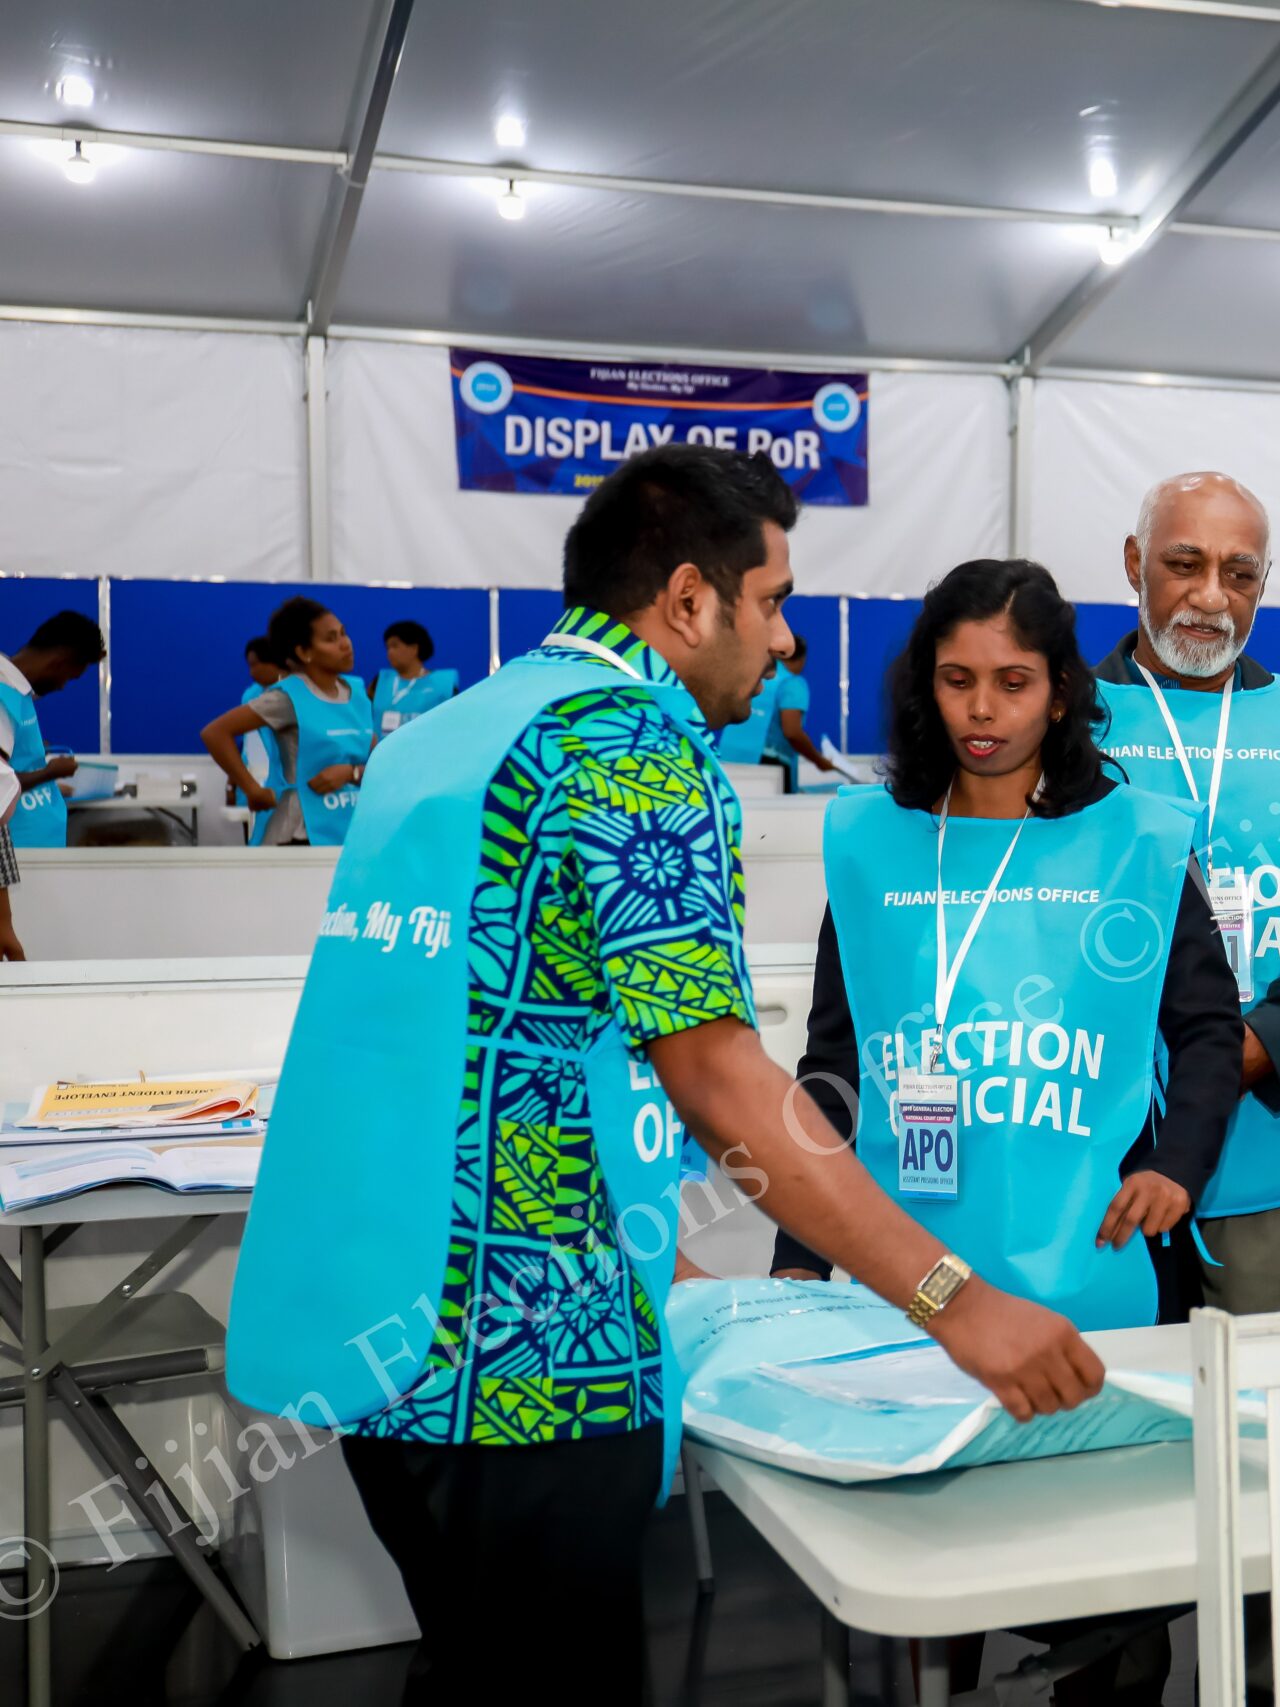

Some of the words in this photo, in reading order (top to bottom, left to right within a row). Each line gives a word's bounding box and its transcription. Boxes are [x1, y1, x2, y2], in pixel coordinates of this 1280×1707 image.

[628, 369, 689, 384] ELECTIONS
[691, 373, 730, 387] OFFICE
[505, 415, 674, 461] DISPLAY
[747, 429, 821, 470] PoR
[884, 891, 936, 907] FIJIAN
[1037, 887, 1100, 904] OFFICE
[361, 901, 403, 953] My
[408, 906, 452, 959] Fiji
[882, 1021, 1105, 1081] ELECTION
[54, 1092, 117, 1101] ENVELOPE
[121, 1089, 172, 1097] EVIDENT
[902, 1128, 954, 1173] APO
